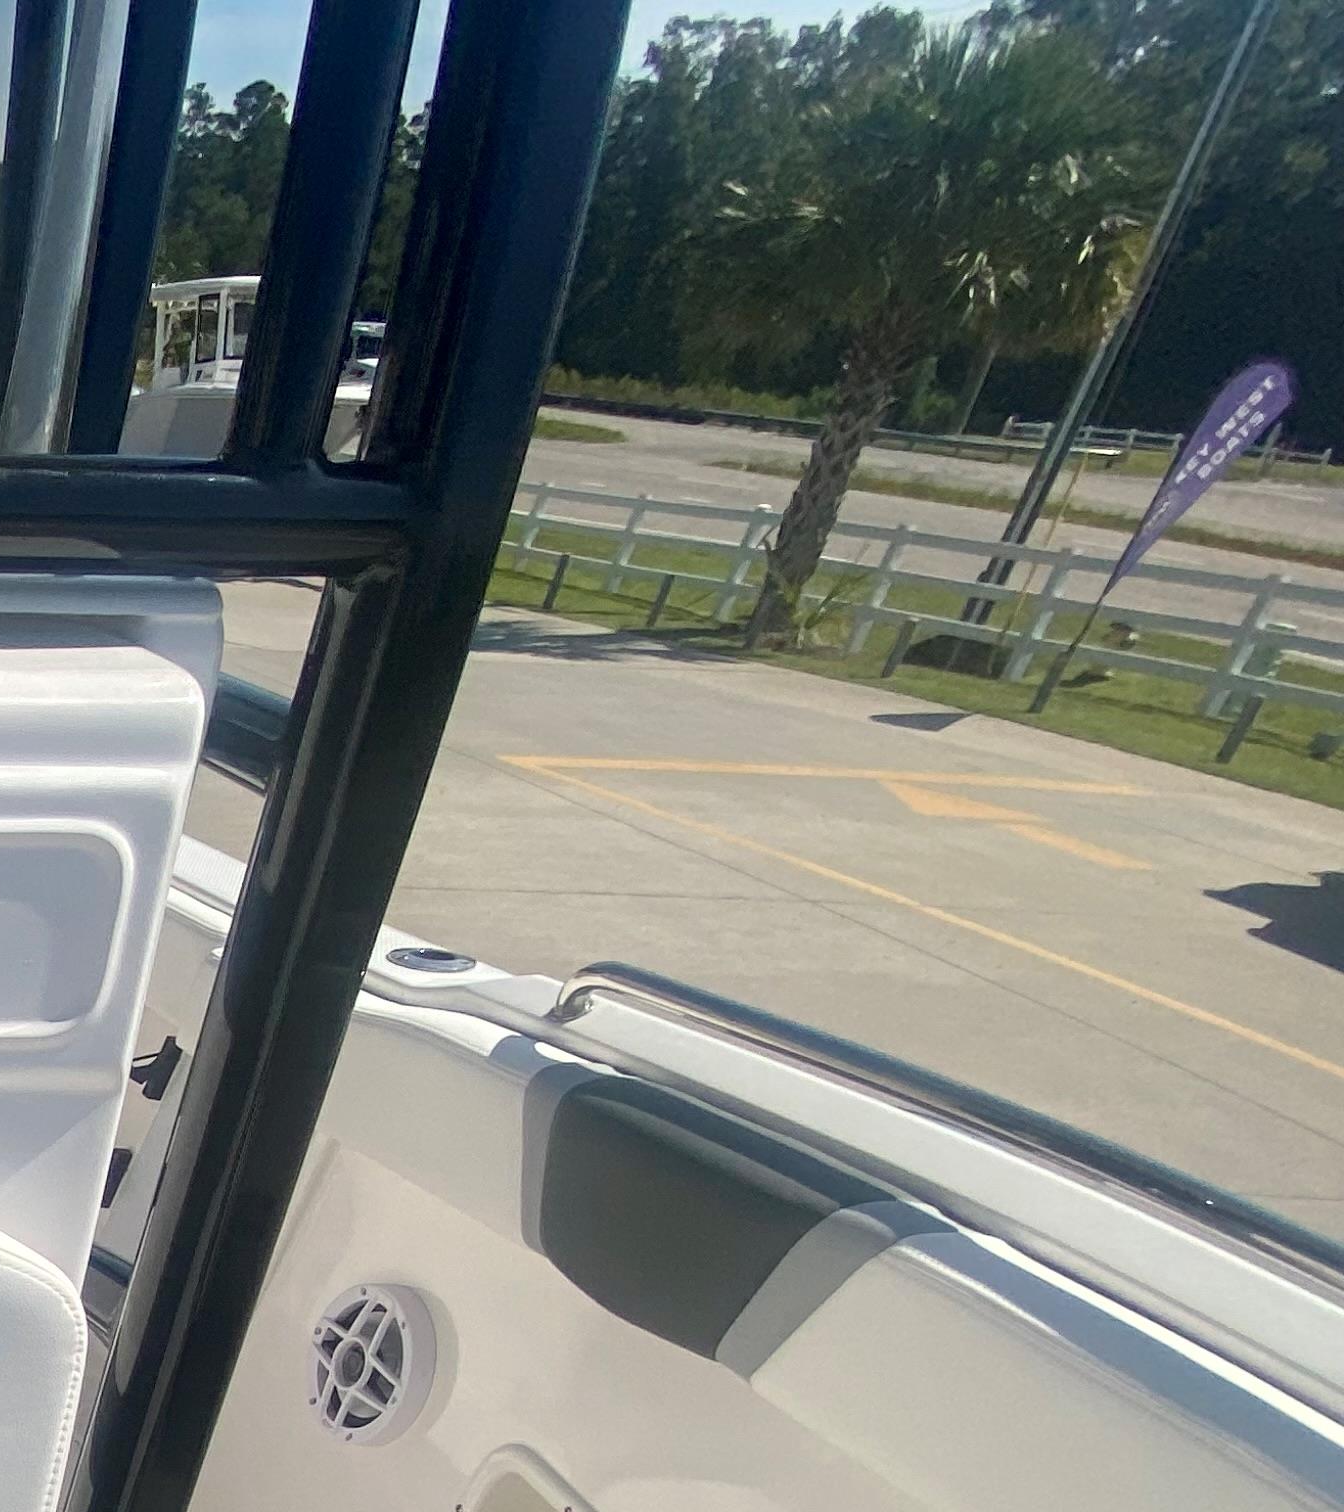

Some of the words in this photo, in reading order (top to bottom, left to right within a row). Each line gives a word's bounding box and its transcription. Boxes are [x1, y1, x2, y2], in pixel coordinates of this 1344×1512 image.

[1174, 443, 1209, 484] KEY
[1215, 375, 1276, 440] WEST
[1196, 411, 1265, 480] BOATS
